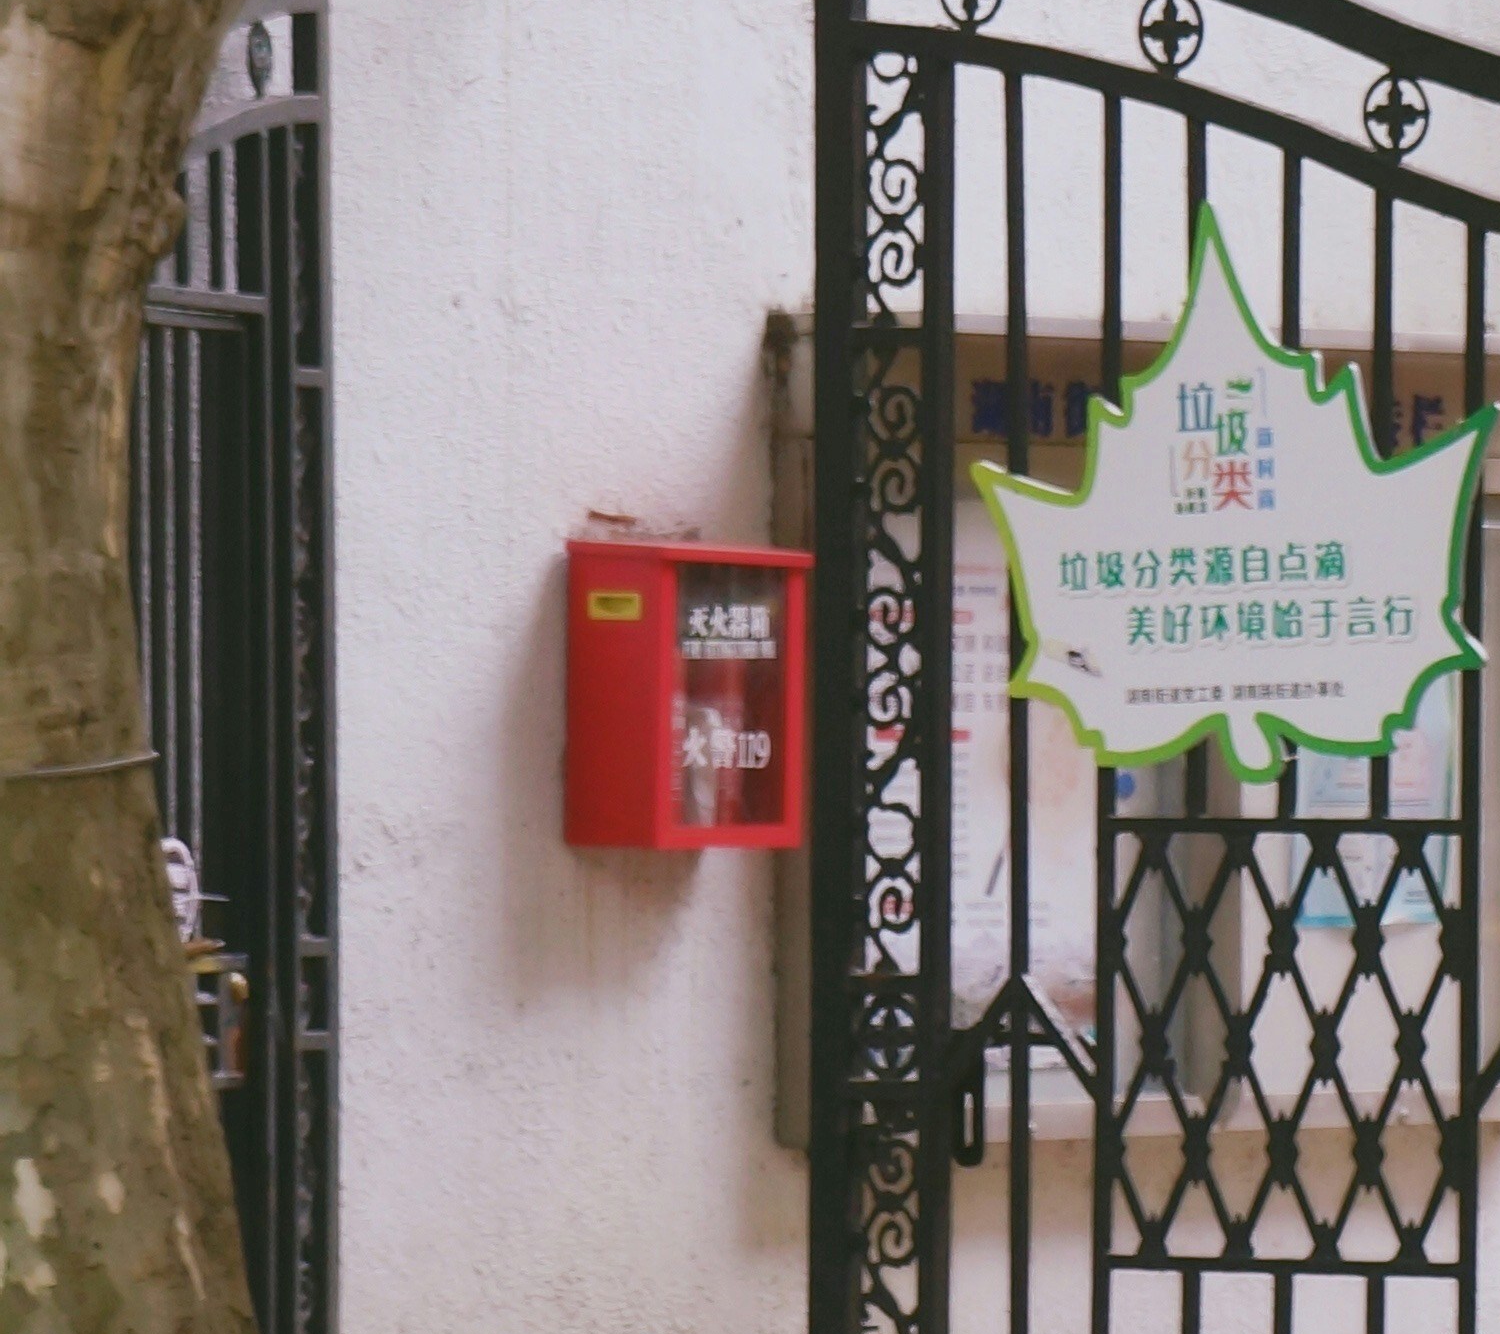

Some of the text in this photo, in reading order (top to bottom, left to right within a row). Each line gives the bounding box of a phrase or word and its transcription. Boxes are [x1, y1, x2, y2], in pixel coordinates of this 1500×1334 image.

[1058, 540, 1347, 591] 垃圾分类源自点滴
[688, 604, 771, 639] 灭火器箱
[1126, 595, 1415, 646] 美好环境始于言行
